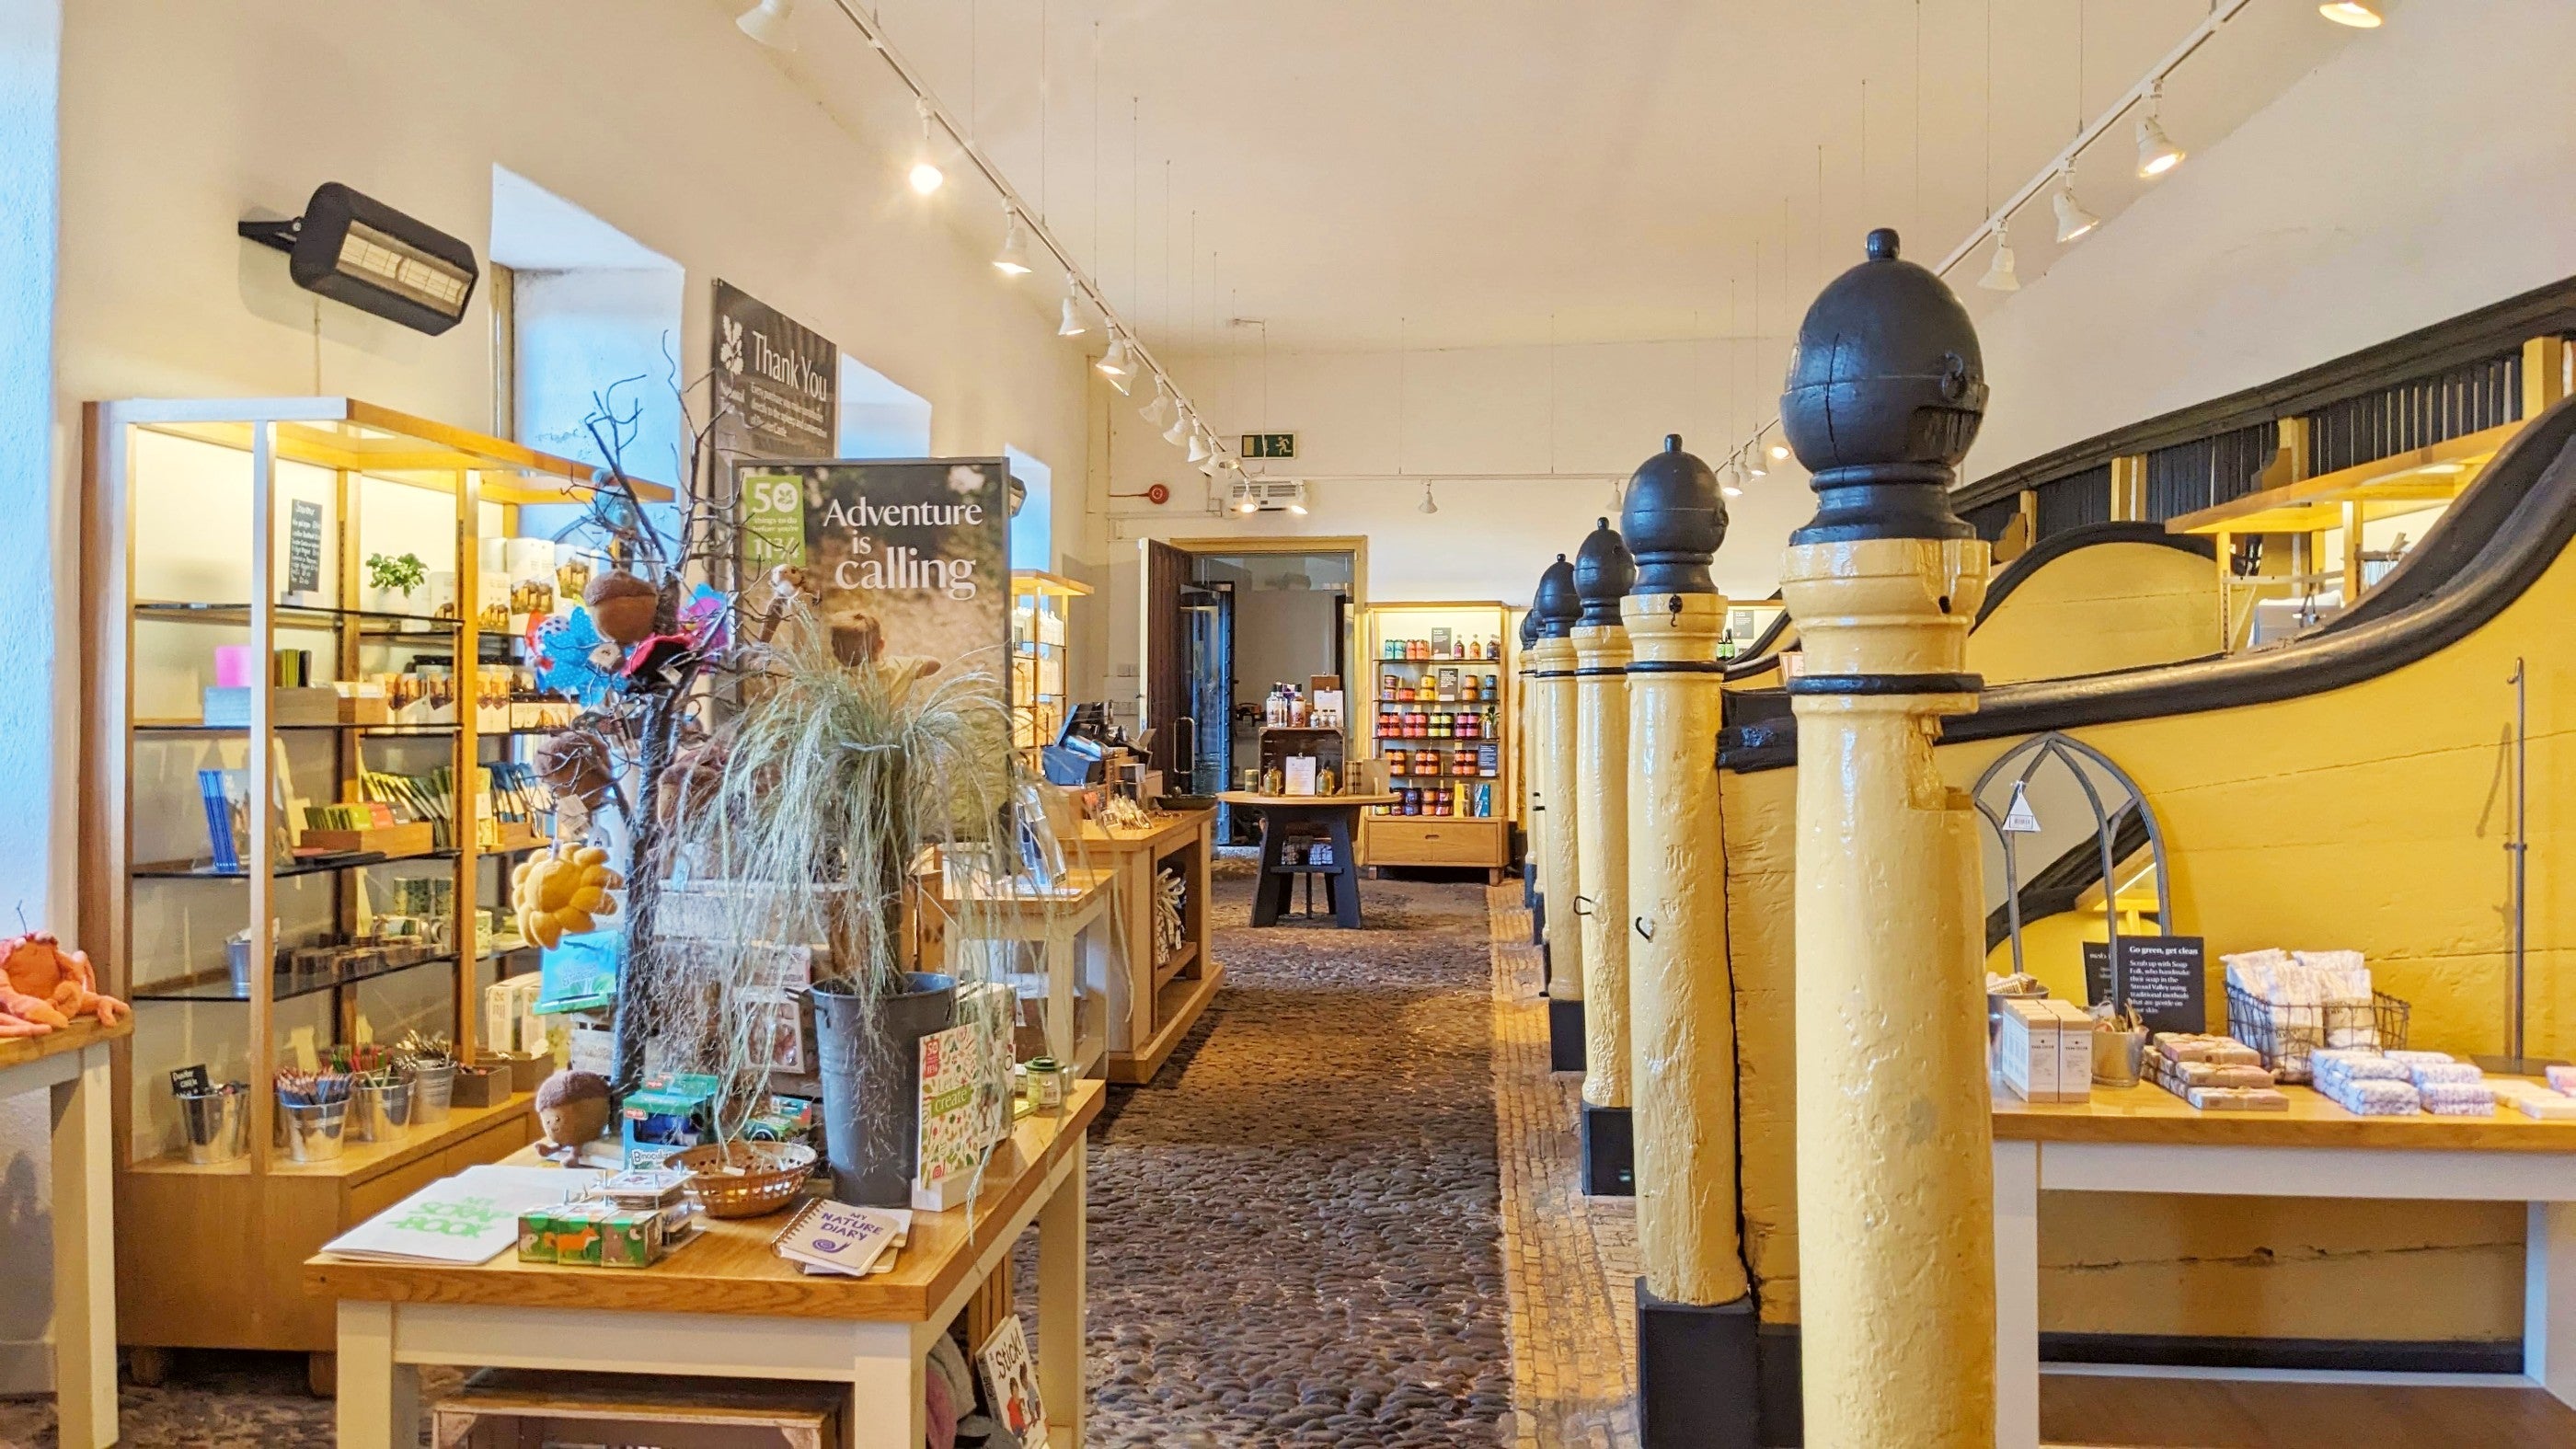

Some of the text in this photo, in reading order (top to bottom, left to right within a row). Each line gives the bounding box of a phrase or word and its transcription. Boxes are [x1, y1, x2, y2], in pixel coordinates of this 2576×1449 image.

[752, 330, 799, 390] Thank
[801, 356, 827, 402] You
[753, 483, 798, 513] 50
[823, 496, 983, 527] Adventure
[852, 529, 872, 554] is
[835, 546, 977, 600] calling
[2129, 946, 2199, 956] Go green, get clean
[934, 1089, 966, 1111] create
[408, 1202, 515, 1222] SCRAP
[821, 1212, 884, 1235] NATURE
[386, 1216, 497, 1238] BOOK
[820, 1222, 868, 1241] DIARY
[995, 1327, 1024, 1380] Stick!
